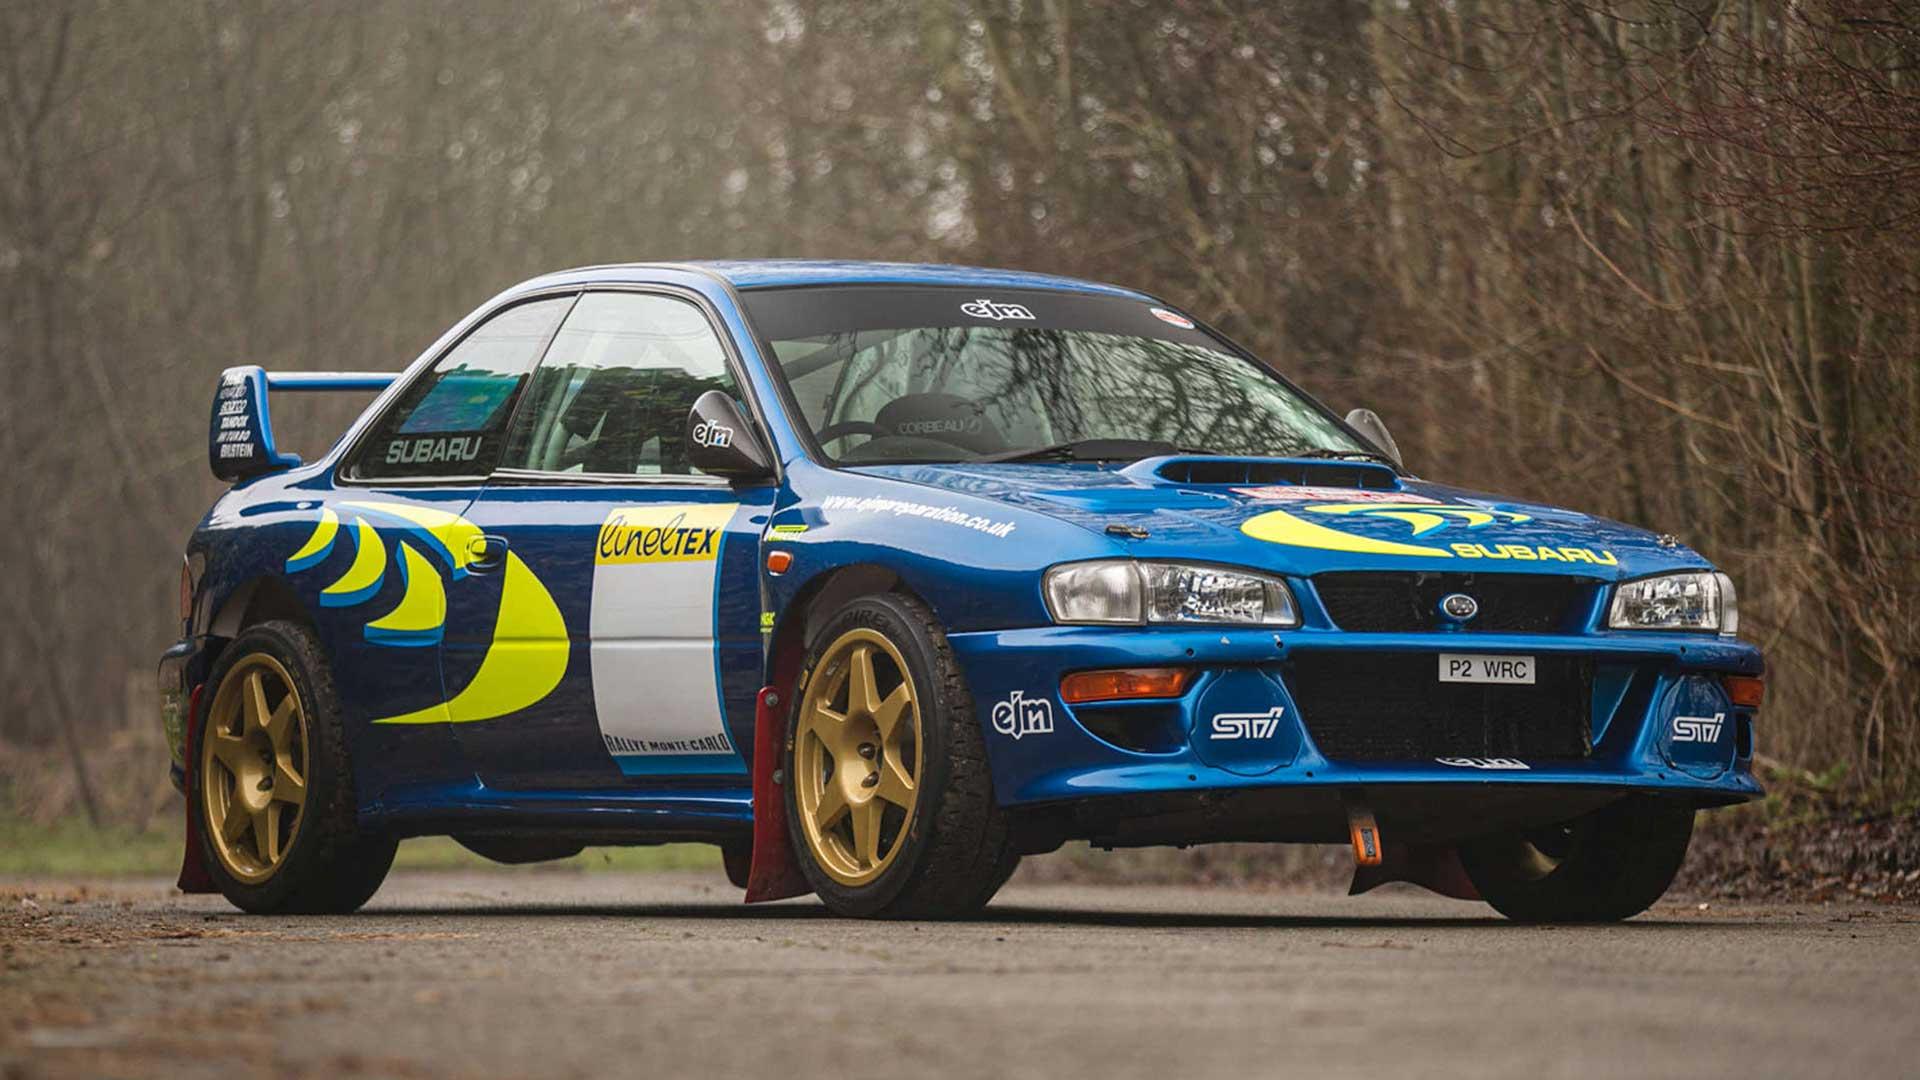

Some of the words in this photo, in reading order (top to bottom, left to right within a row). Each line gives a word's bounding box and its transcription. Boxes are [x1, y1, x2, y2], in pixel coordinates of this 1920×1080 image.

[385, 436, 482, 464] SUBARU
[1450, 543, 1618, 565] SUBARU
[1449, 659, 1472, 677] P2
[1483, 660, 1527, 679] WRC
[992, 690, 1054, 740] ejm
[604, 733, 648, 753] RALLYE
